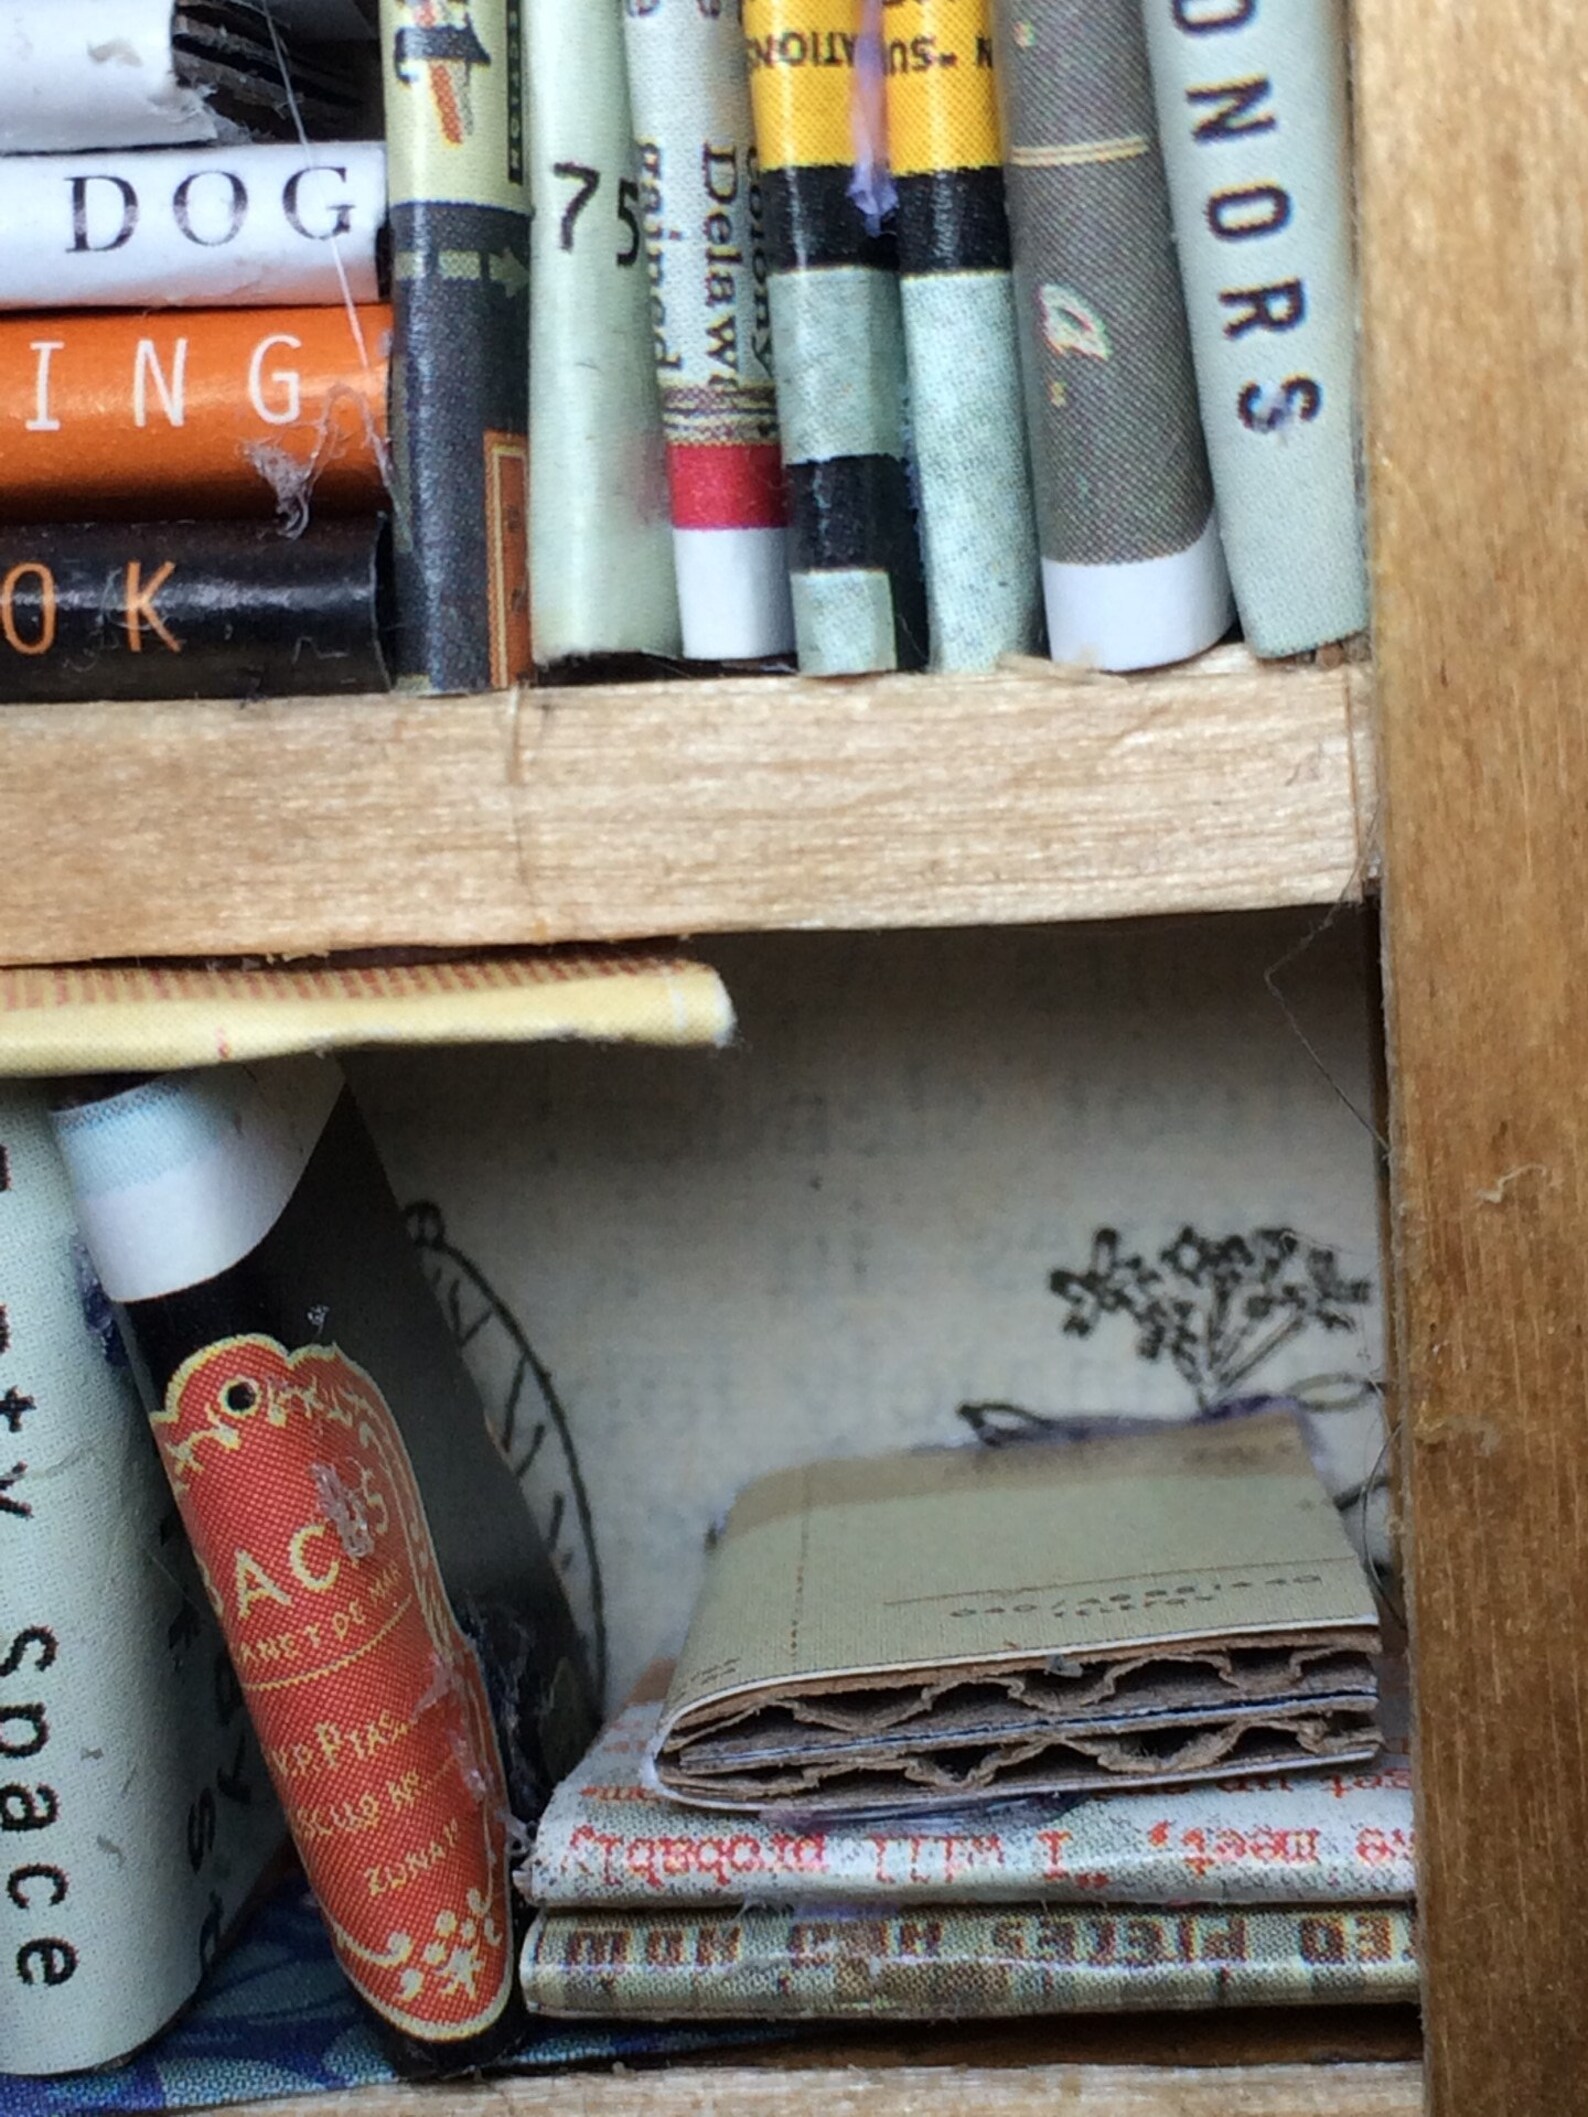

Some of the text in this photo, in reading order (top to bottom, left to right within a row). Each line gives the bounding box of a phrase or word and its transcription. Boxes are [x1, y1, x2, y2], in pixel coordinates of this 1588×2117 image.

[64, 166, 356, 253] DOG
[554, 161, 641, 268] 75
[26, 334, 302, 431] ING
[2, 560, 181, 655] OK
[0, 1624, 79, 1987] Space
